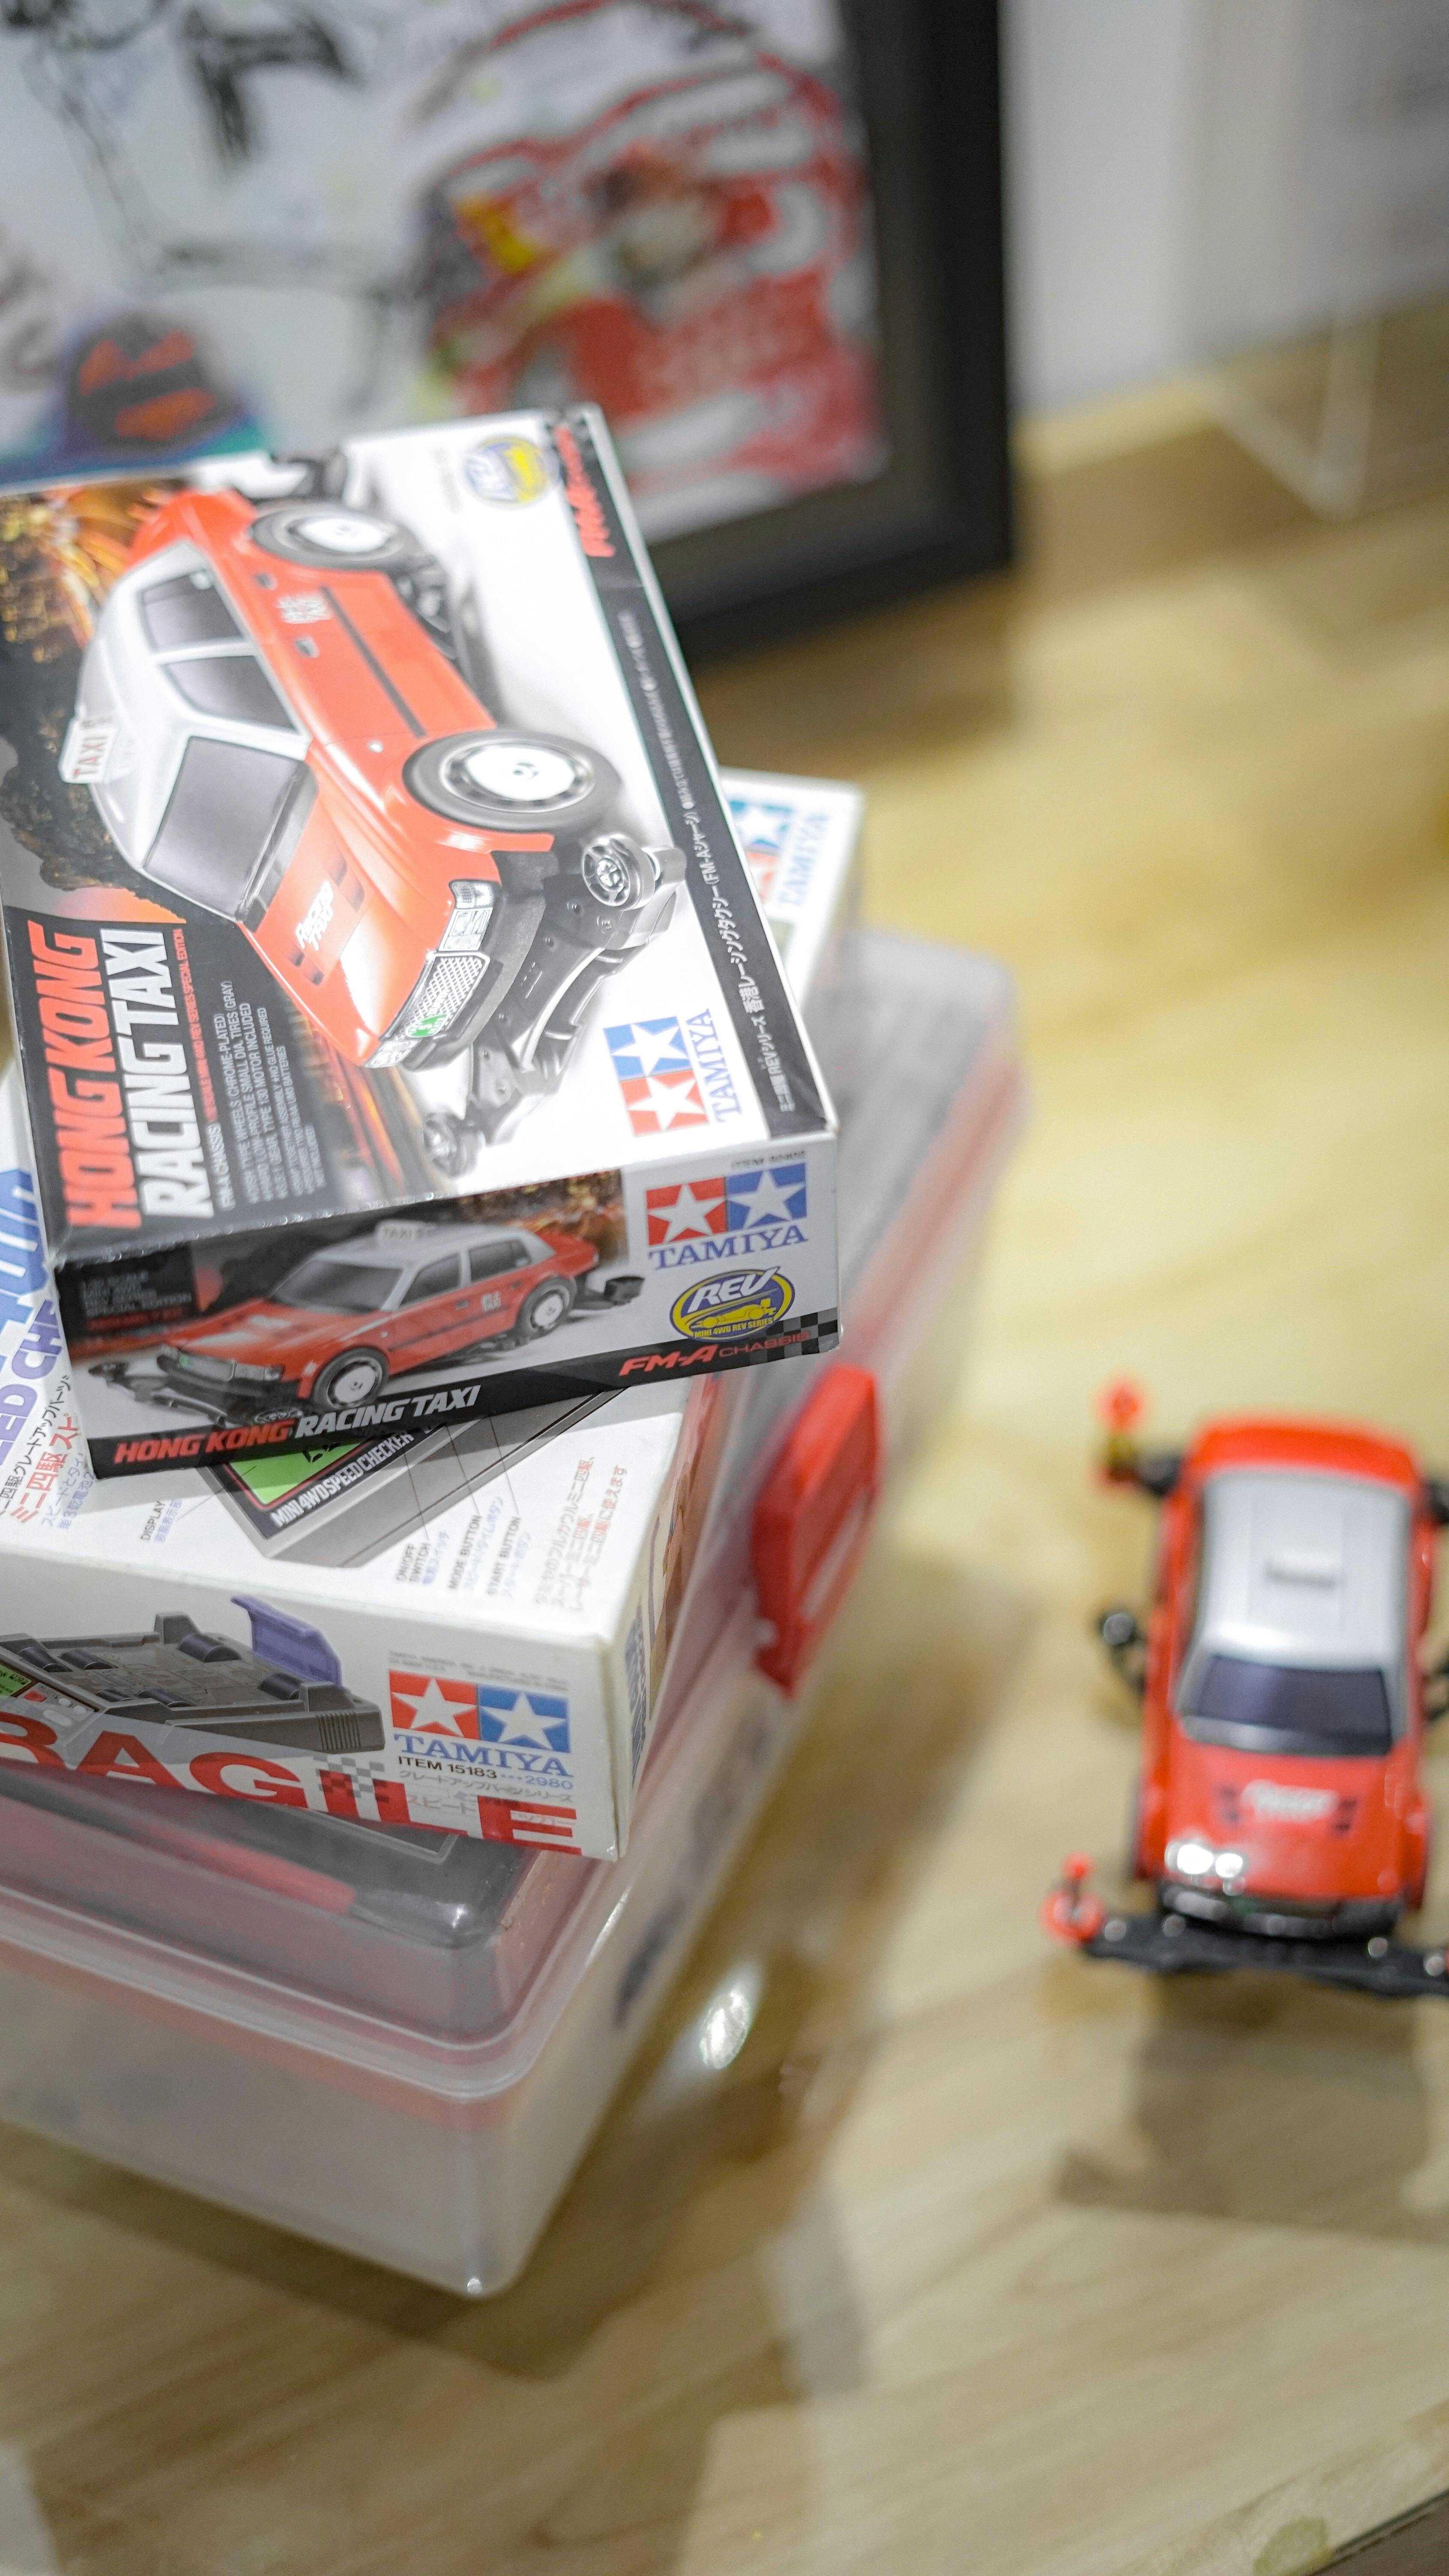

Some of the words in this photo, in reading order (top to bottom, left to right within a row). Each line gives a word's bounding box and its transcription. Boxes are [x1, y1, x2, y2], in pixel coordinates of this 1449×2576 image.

[173, 928, 188, 961] EDITION
[28, 920, 116, 1072] KONG
[100, 928, 179, 1034] TAXI
[220, 980, 237, 1012] (GRAY)
[226, 1011, 243, 1039] TIRES
[238, 1002, 258, 1051] INCLUDED
[257, 1007, 273, 1044] REQUIRED
[212, 1013, 240, 1100] (CHROME-PLATED)
[236, 1060, 253, 1094] SMALL
[248, 1051, 266, 1088] MOTOR
[687, 1008, 742, 1123] TAMIYA
[48, 1070, 142, 1228] HONG
[118, 1036, 215, 1217] RACING
[649, 1224, 808, 1270] TAMIYA
[689, 1266, 781, 1313] REV
[694, 1329, 712, 1338] MINI
[712, 1325, 731, 1334] 4WD
[731, 1322, 747, 1331] REV
[747, 1317, 774, 1328] SERIES
[618, 1345, 719, 1376] FM-A
[719, 1331, 809, 1358] CHASSIS
[115, 1430, 200, 1464] HONG
[206, 1420, 294, 1452] KONG
[295, 1399, 406, 1438] RACING
[412, 1385, 480, 1415] TAXI
[10, 1452, 68, 1523] ミニ四駆
[271, 1501, 304, 1528] MINI
[322, 1461, 365, 1495] SPEED
[140, 1500, 166, 1540] DISPLAY
[409, 1541, 430, 1581] SWITCH
[448, 1558, 467, 1590] MODE
[460, 1513, 482, 1556] BUTTON
[487, 1561, 506, 1595] START
[499, 1515, 521, 1557] BUTTON
[395, 1733, 573, 1777] TAMIYA
[398, 1756, 442, 1771] ITEM
[447, 1763, 497, 1779] 15183
